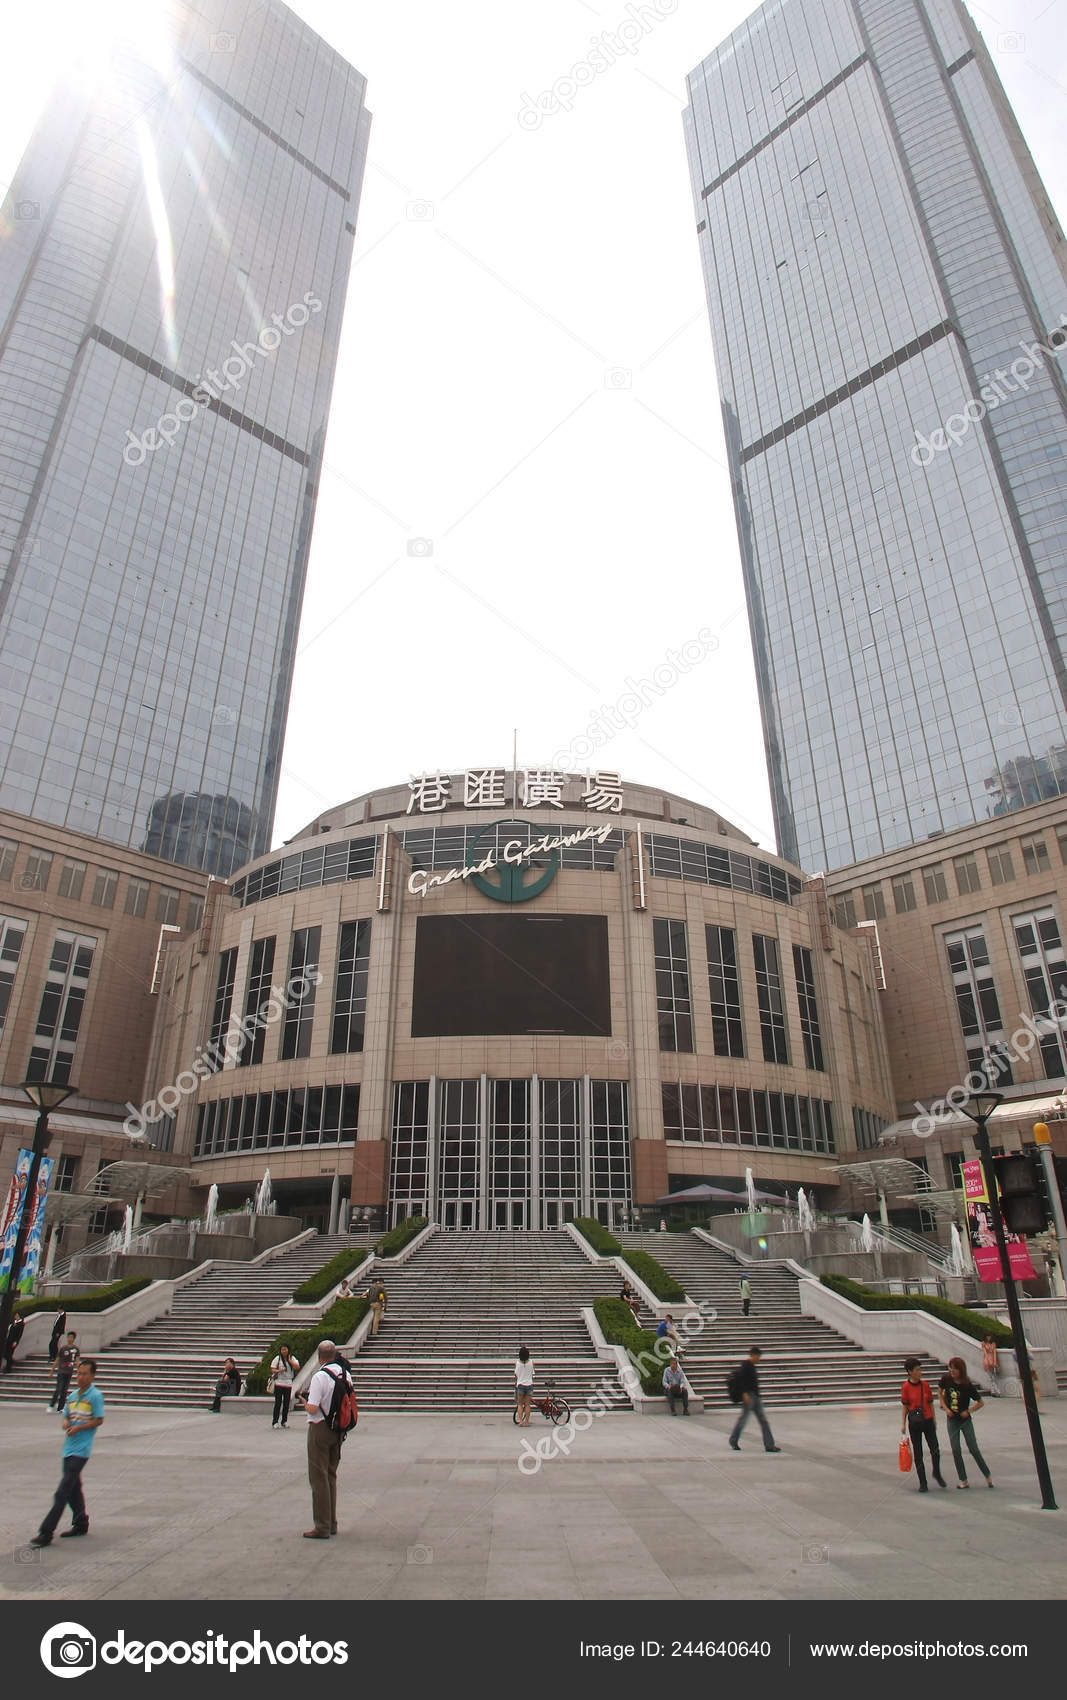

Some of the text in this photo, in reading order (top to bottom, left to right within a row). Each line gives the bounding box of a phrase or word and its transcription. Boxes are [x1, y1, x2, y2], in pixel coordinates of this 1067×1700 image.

[406, 767, 624, 814] 港匯廣場
[407, 822, 613, 898] Grand Gateway
